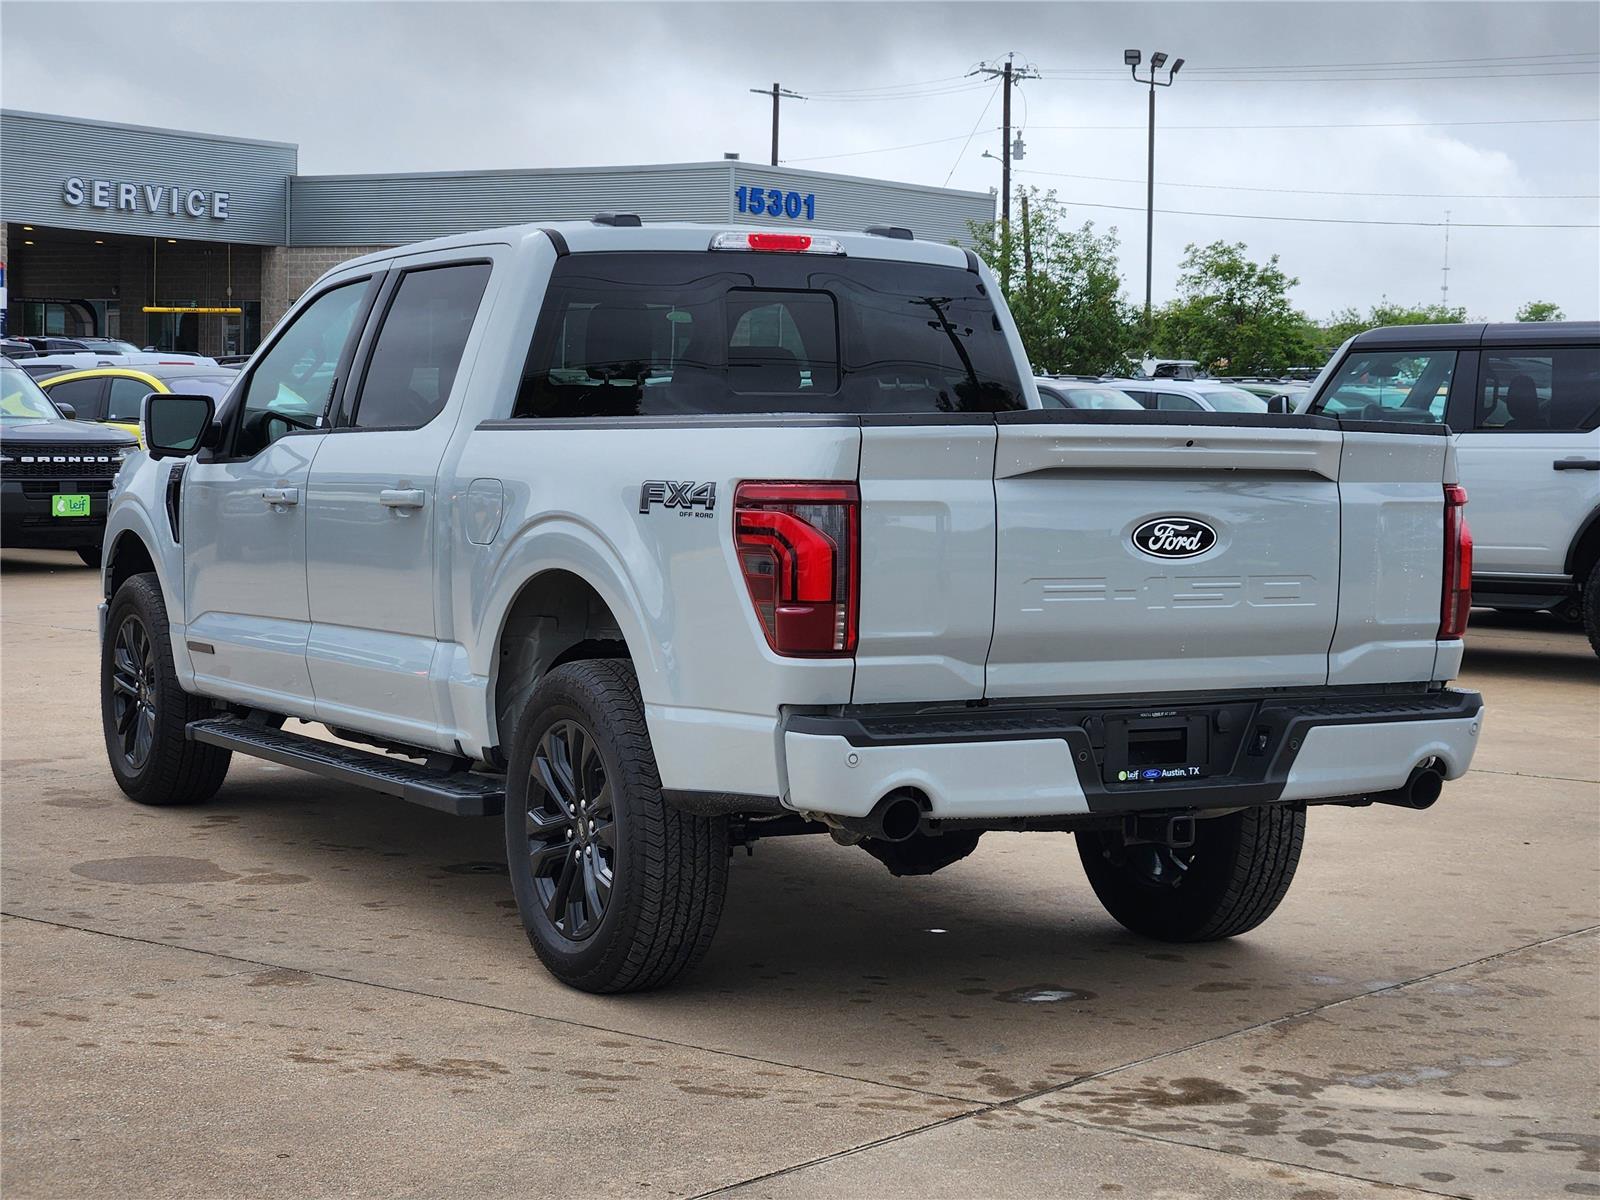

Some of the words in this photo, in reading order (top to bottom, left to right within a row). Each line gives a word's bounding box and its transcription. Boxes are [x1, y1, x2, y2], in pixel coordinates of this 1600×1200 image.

[63, 175, 230, 219] SERVICE
[735, 186, 815, 220] 15301
[638, 480, 717, 514] FX4
[1148, 523, 1202, 551] Ford
[1020, 575, 1317, 612] F-150
[1162, 768, 1187, 777] Austin,
[1188, 767, 1200, 775] TX
